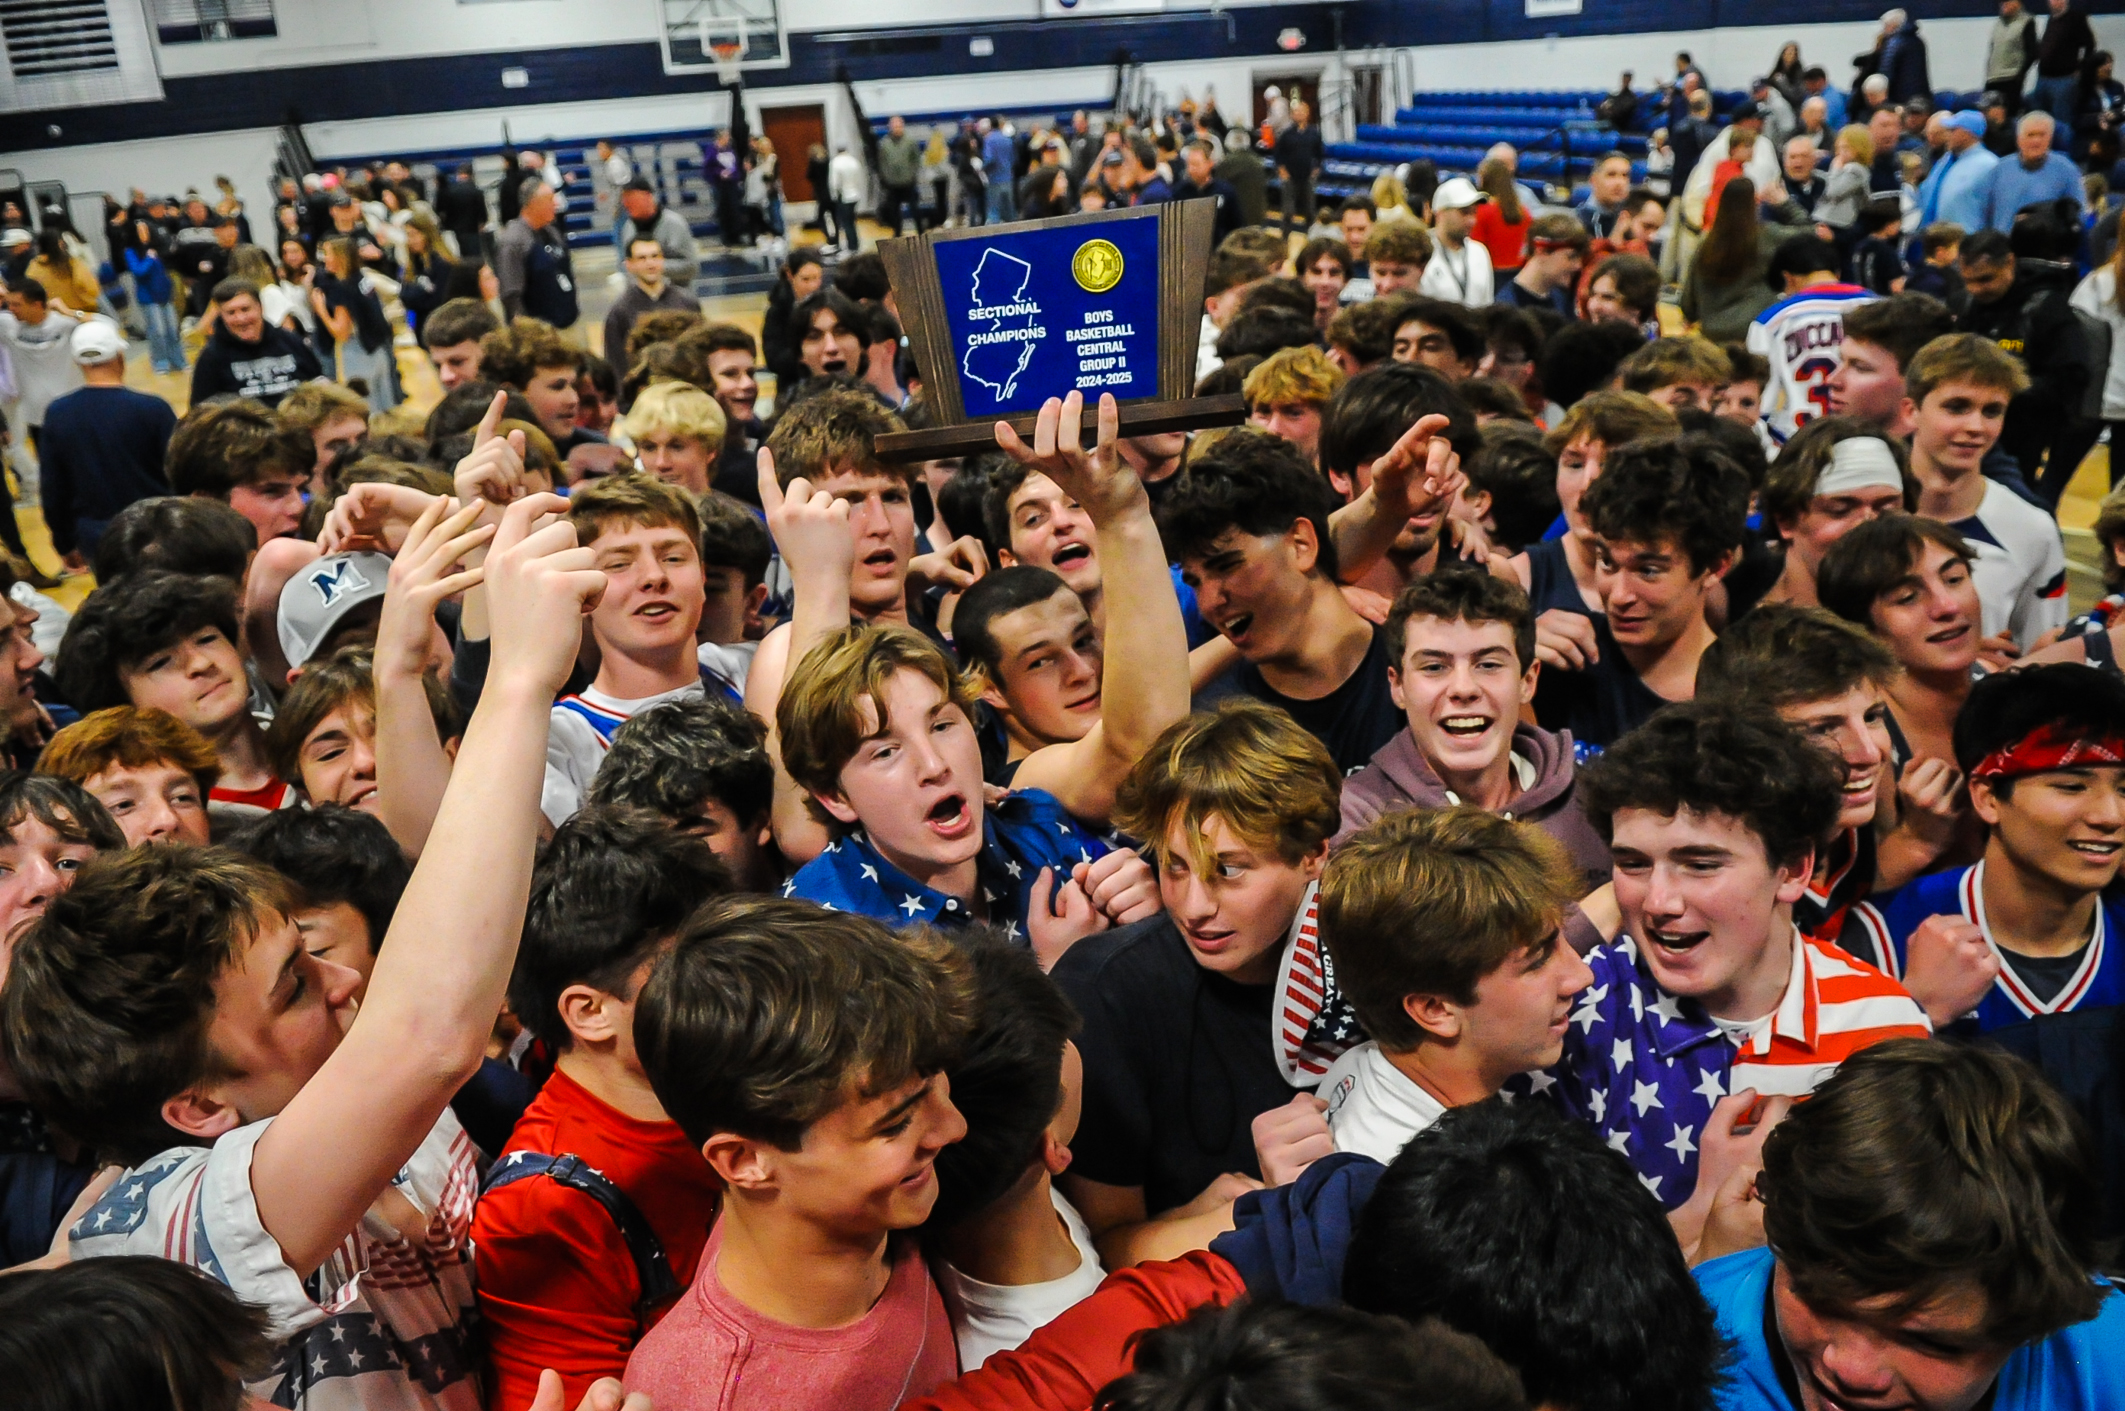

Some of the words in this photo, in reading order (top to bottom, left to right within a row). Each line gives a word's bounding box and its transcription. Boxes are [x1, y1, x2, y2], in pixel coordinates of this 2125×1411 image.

[968, 302, 1041, 320] SECTIONAL
[1084, 309, 1114, 325] BOYS
[967, 326, 1047, 346] CHAMPIONS
[1065, 323, 1135, 342] BASKETBALL
[1077, 340, 1127, 357] CENTRAL
[1080, 356, 1116, 372] GROUP
[1118, 355, 1126, 368] II
[1075, 371, 1133, 389] 2024-2025
[308, 557, 371, 609] M
